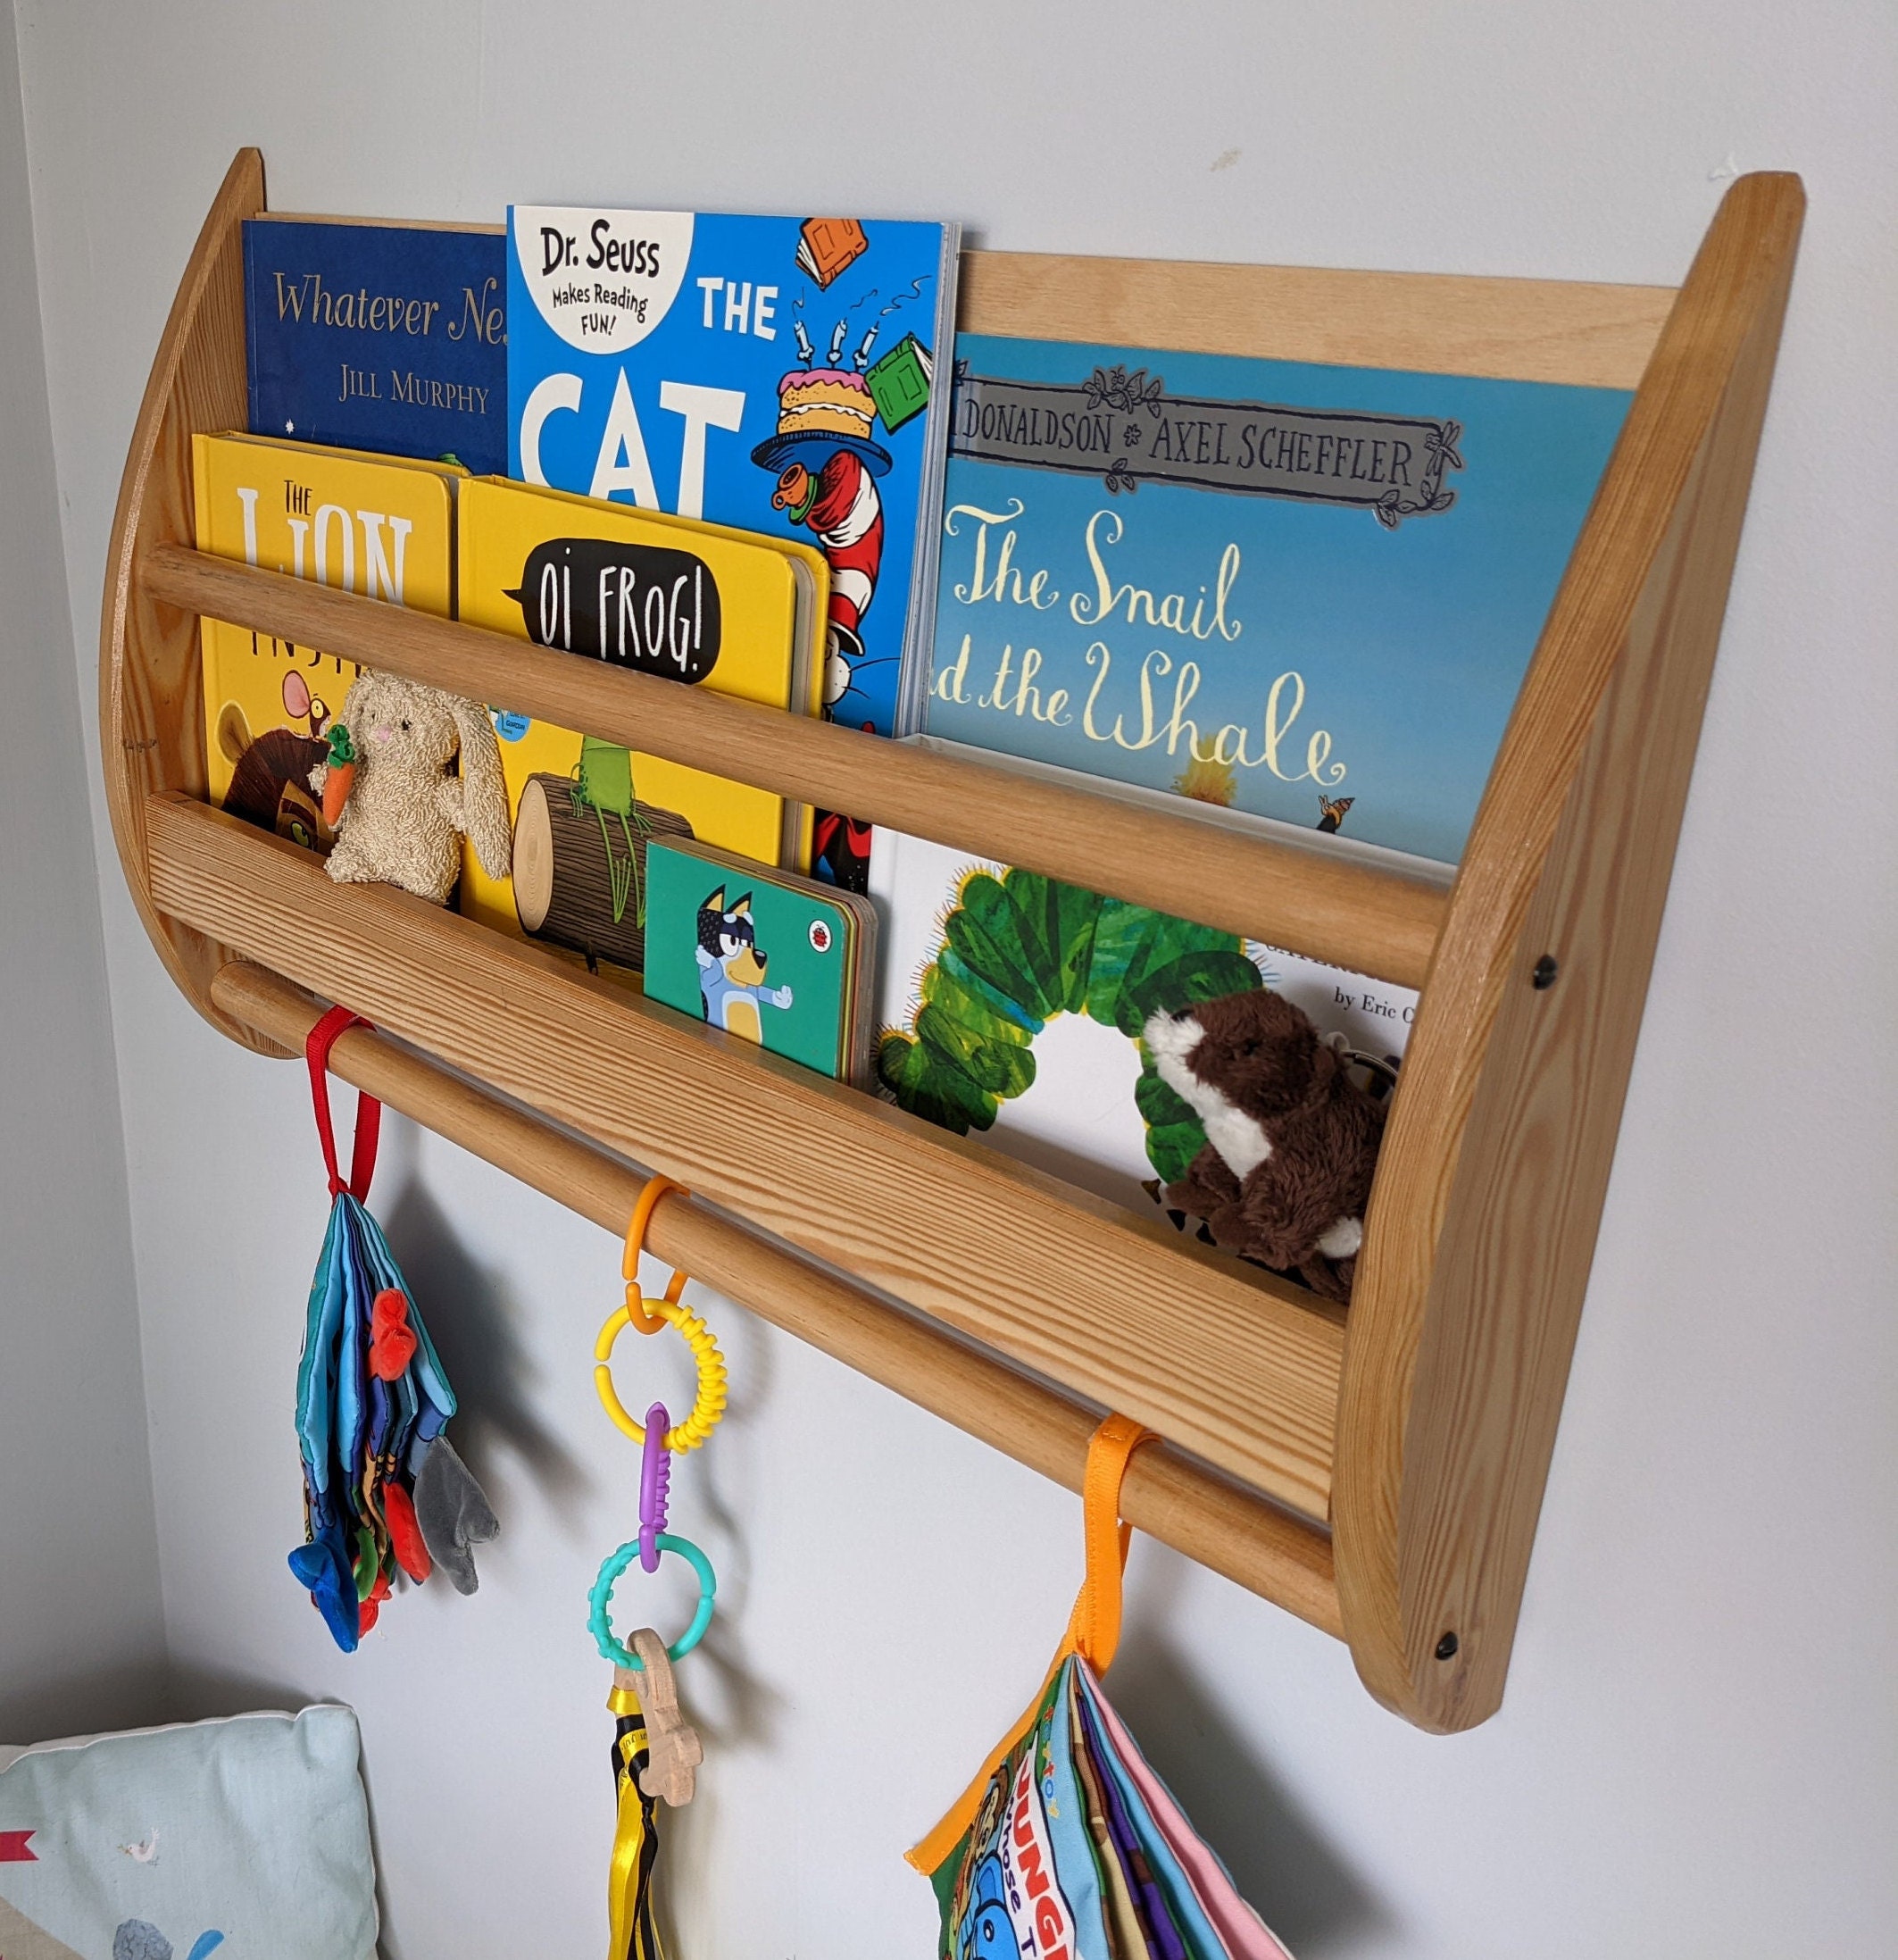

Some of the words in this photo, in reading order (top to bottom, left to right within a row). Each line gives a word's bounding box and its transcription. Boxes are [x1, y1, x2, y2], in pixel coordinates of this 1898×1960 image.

[540, 227, 579, 278] Dr.
[586, 219, 661, 278] Seuss
[273, 271, 439, 336] Whatever
[448, 278, 508, 346] Ne
[553, 283, 590, 309] Makes
[594, 282, 649, 323] Reading
[581, 314, 617, 337] FUN!
[696, 276, 778, 342] THE
[339, 364, 382, 403] JILL
[390, 371, 489, 414] MURPHY
[520, 366, 746, 521] CAT
[962, 398, 1116, 454] DONALDSON
[1148, 417, 1230, 467] AXEL
[1236, 424, 1412, 487] SCHEFFLER
[283, 480, 313, 516] THE
[945, 498, 1060, 610] The
[1070, 510, 1242, 641] Snail
[599, 564, 703, 672] FROG!
[929, 633, 971, 704] d
[978, 644, 1071, 727] the
[1082, 641, 1346, 786] Whale
[1334, 987, 1356, 1010] by
[1361, 994, 1397, 1019] Eric
